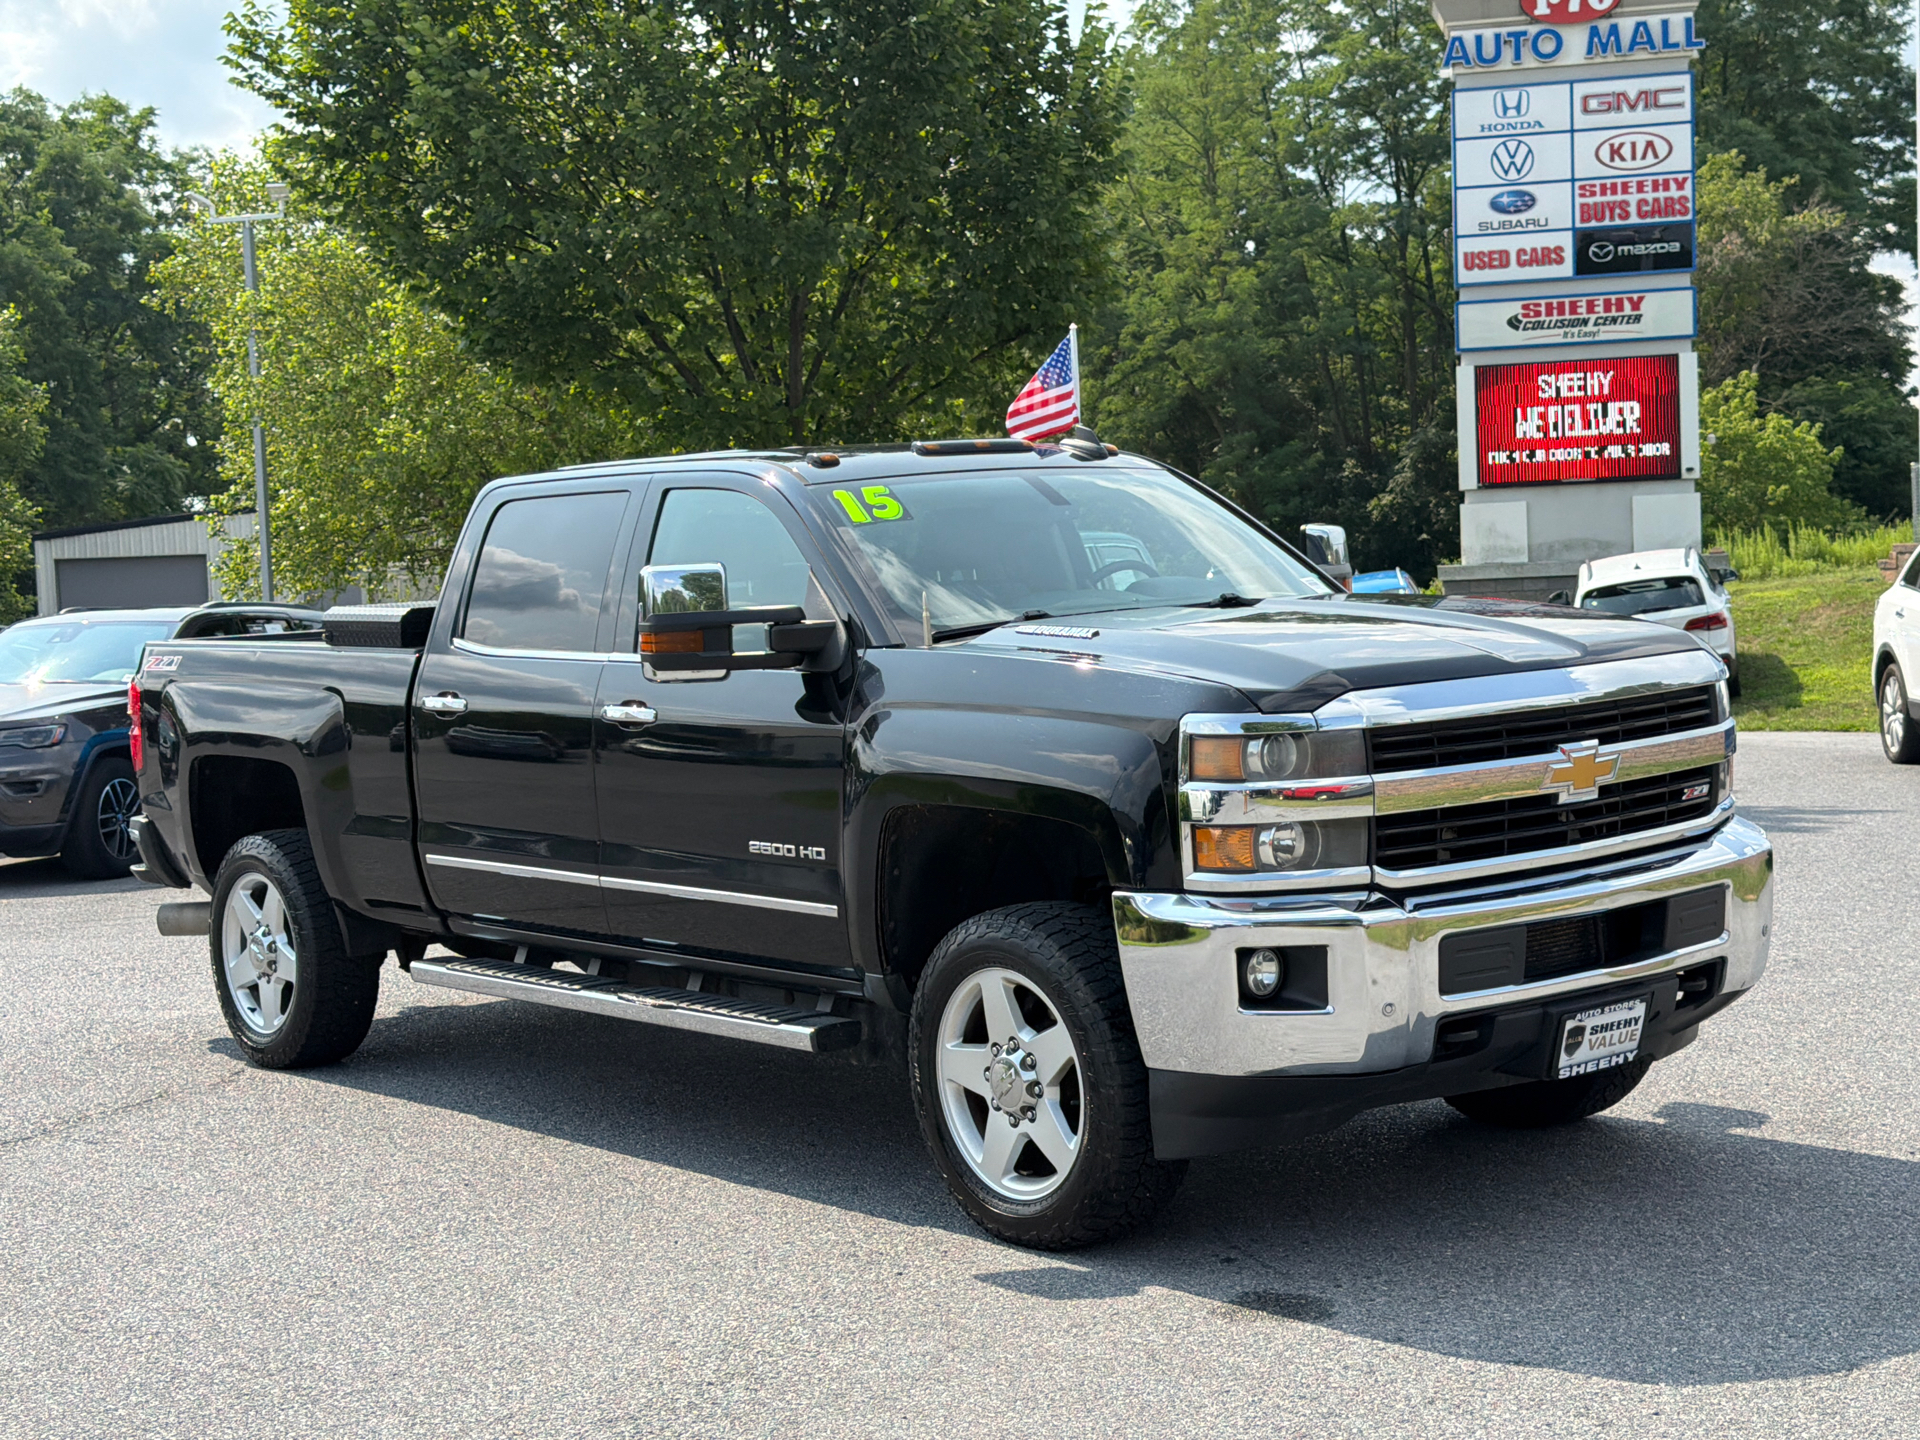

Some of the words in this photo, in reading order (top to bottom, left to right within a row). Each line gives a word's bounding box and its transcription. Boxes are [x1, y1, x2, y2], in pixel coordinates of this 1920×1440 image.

[1442, 28, 1564, 68] AUTO
[1584, 17, 1706, 58] MALL
[1581, 85, 1685, 116] GMC
[1478, 119, 1545, 134] HONDA
[1608, 139, 1660, 163] KIA
[1577, 176, 1690, 198] SHEEHY
[1579, 199, 1631, 223] BUYS
[1635, 195, 1690, 219] CARS
[1477, 217, 1549, 232] SUBARU
[1463, 249, 1511, 271] USED
[1515, 245, 1565, 268] CARS
[1617, 241, 1681, 257] mazda
[1520, 295, 1646, 319] SHEEHY
[1521, 316, 1591, 332] COLLISION
[1592, 313, 1643, 328] CENTER
[1562, 330, 1575, 339] It's
[1577, 328, 1601, 339] Easy!
[1538, 370, 1614, 399] SHEEHY
[833, 485, 904, 523] 15
[144, 655, 183, 671] Z71
[748, 840, 796, 857] 2500
[799, 845, 826, 860] HD
[1574, 1008, 1602, 1022] AUTO
[1603, 999, 1641, 1014] STORES
[1588, 1015, 1642, 1036] SHEEHY
[1588, 1028, 1640, 1051] VALUE
[1558, 1050, 1639, 1079] SHEEHY
